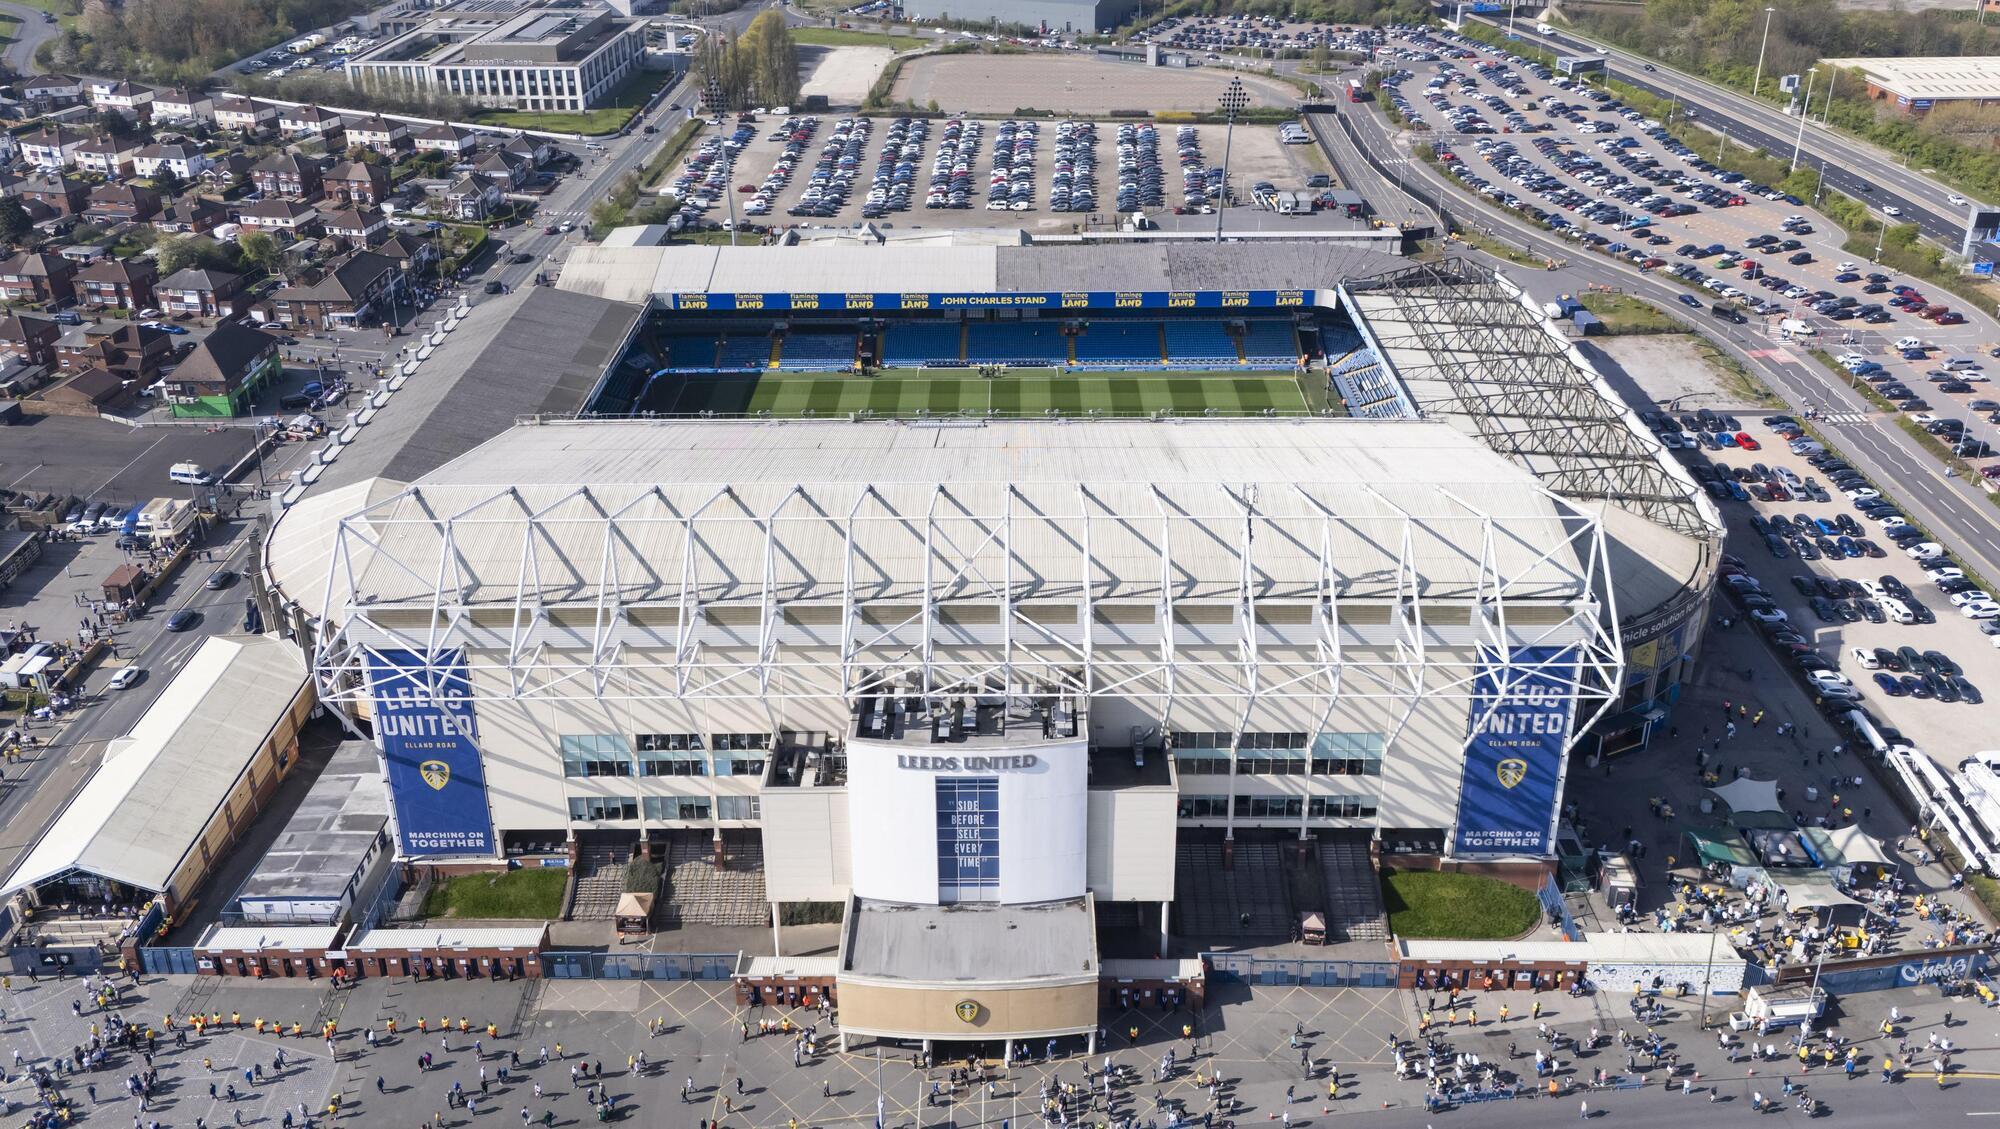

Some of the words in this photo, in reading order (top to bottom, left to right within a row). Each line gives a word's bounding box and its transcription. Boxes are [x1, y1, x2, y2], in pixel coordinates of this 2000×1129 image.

[940, 297, 967, 305] JOHN
[1014, 296, 1047, 304] STAND
[1062, 299, 1088, 307] LAND
[1115, 299, 1142, 307] LAND
[1168, 299, 1195, 307] LAND
[1276, 298, 1303, 306] LAND
[679, 301, 708, 309] LAND
[736, 301, 764, 309] LAND
[791, 301, 819, 309] LAND
[846, 301, 874, 309] LAND
[901, 301, 929, 309] LAND
[1650, 609, 1685, 633] solution
[382, 715, 473, 736] UNITED
[1473, 713, 1564, 734] UNITED
[897, 755, 958, 770] LEEDS
[963, 754, 1038, 770] UNITED
[951, 815, 984, 825] BEFORE
[410, 839, 485, 848] TOGETHER
[1464, 838, 1540, 846] TOGETHER
[954, 843, 983, 853] EVERY
